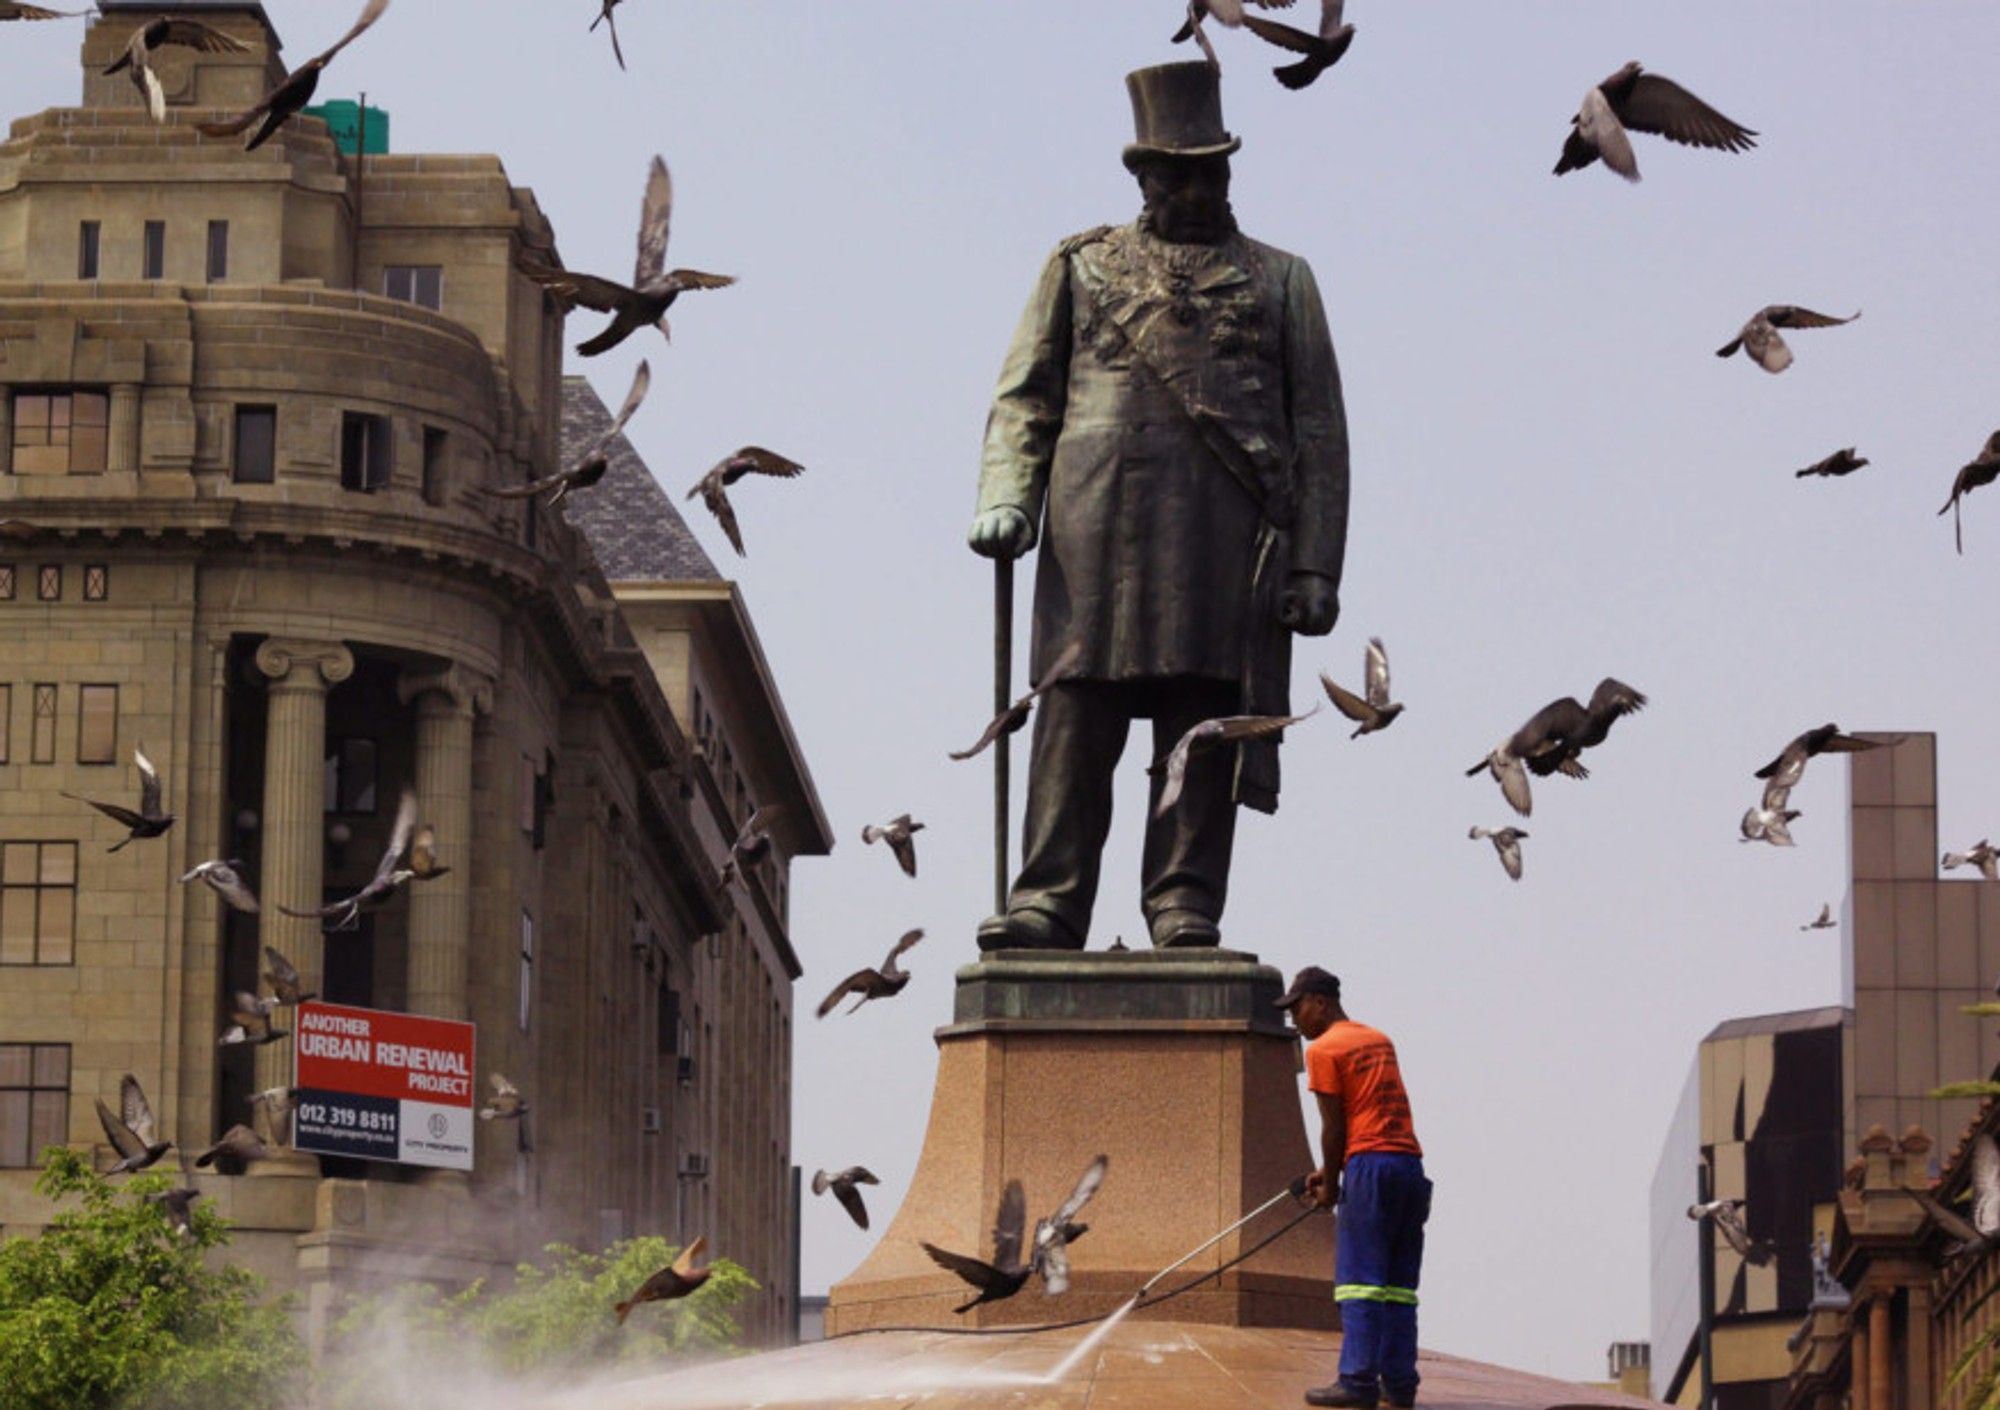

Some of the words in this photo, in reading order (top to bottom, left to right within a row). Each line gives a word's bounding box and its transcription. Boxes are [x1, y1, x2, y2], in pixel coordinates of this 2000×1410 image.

[302, 1013, 370, 1036] ANOTHER
[301, 1033, 370, 1063] URBAN
[376, 1042, 469, 1076] RENEWAL
[408, 1072, 469, 1096] PROJECT
[300, 1103, 326, 1124] 012
[329, 1106, 356, 1127] 319
[359, 1110, 395, 1132] 8811
